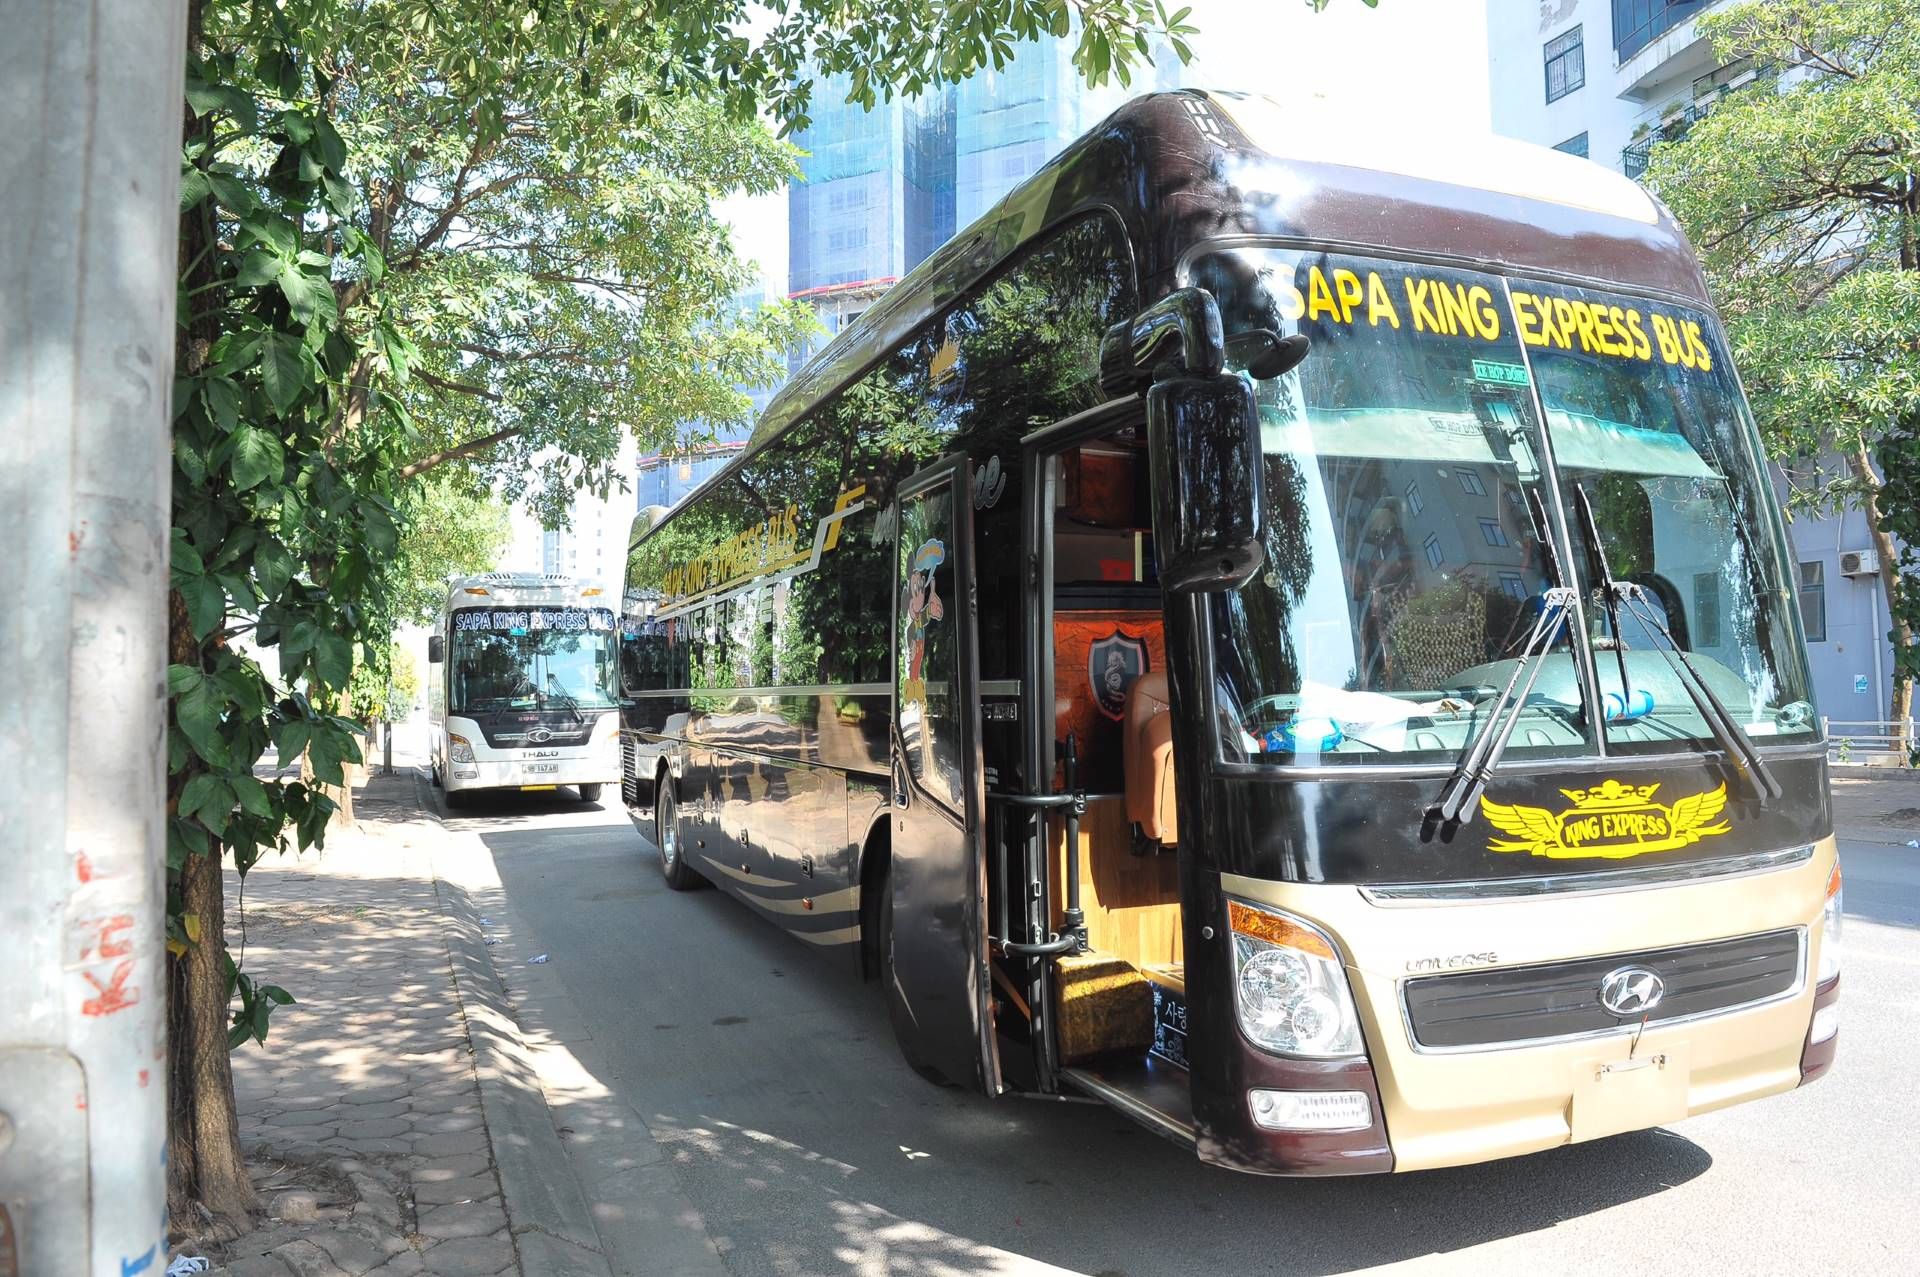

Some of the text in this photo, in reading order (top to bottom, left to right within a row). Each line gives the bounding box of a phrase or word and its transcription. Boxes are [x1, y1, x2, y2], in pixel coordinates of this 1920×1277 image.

[1275, 262, 1712, 372] SAPA KING EXPRESS BUS
[685, 551, 708, 596] KING
[711, 522, 763, 586] EXPRESS
[766, 503, 798, 561] BUS
[456, 612, 491, 631] SAPA
[493, 611, 528, 630] KING
[530, 611, 586, 630] EXPRESS
[588, 612, 614, 631] BUS
[1564, 813, 1668, 848] KING EXPRESS
